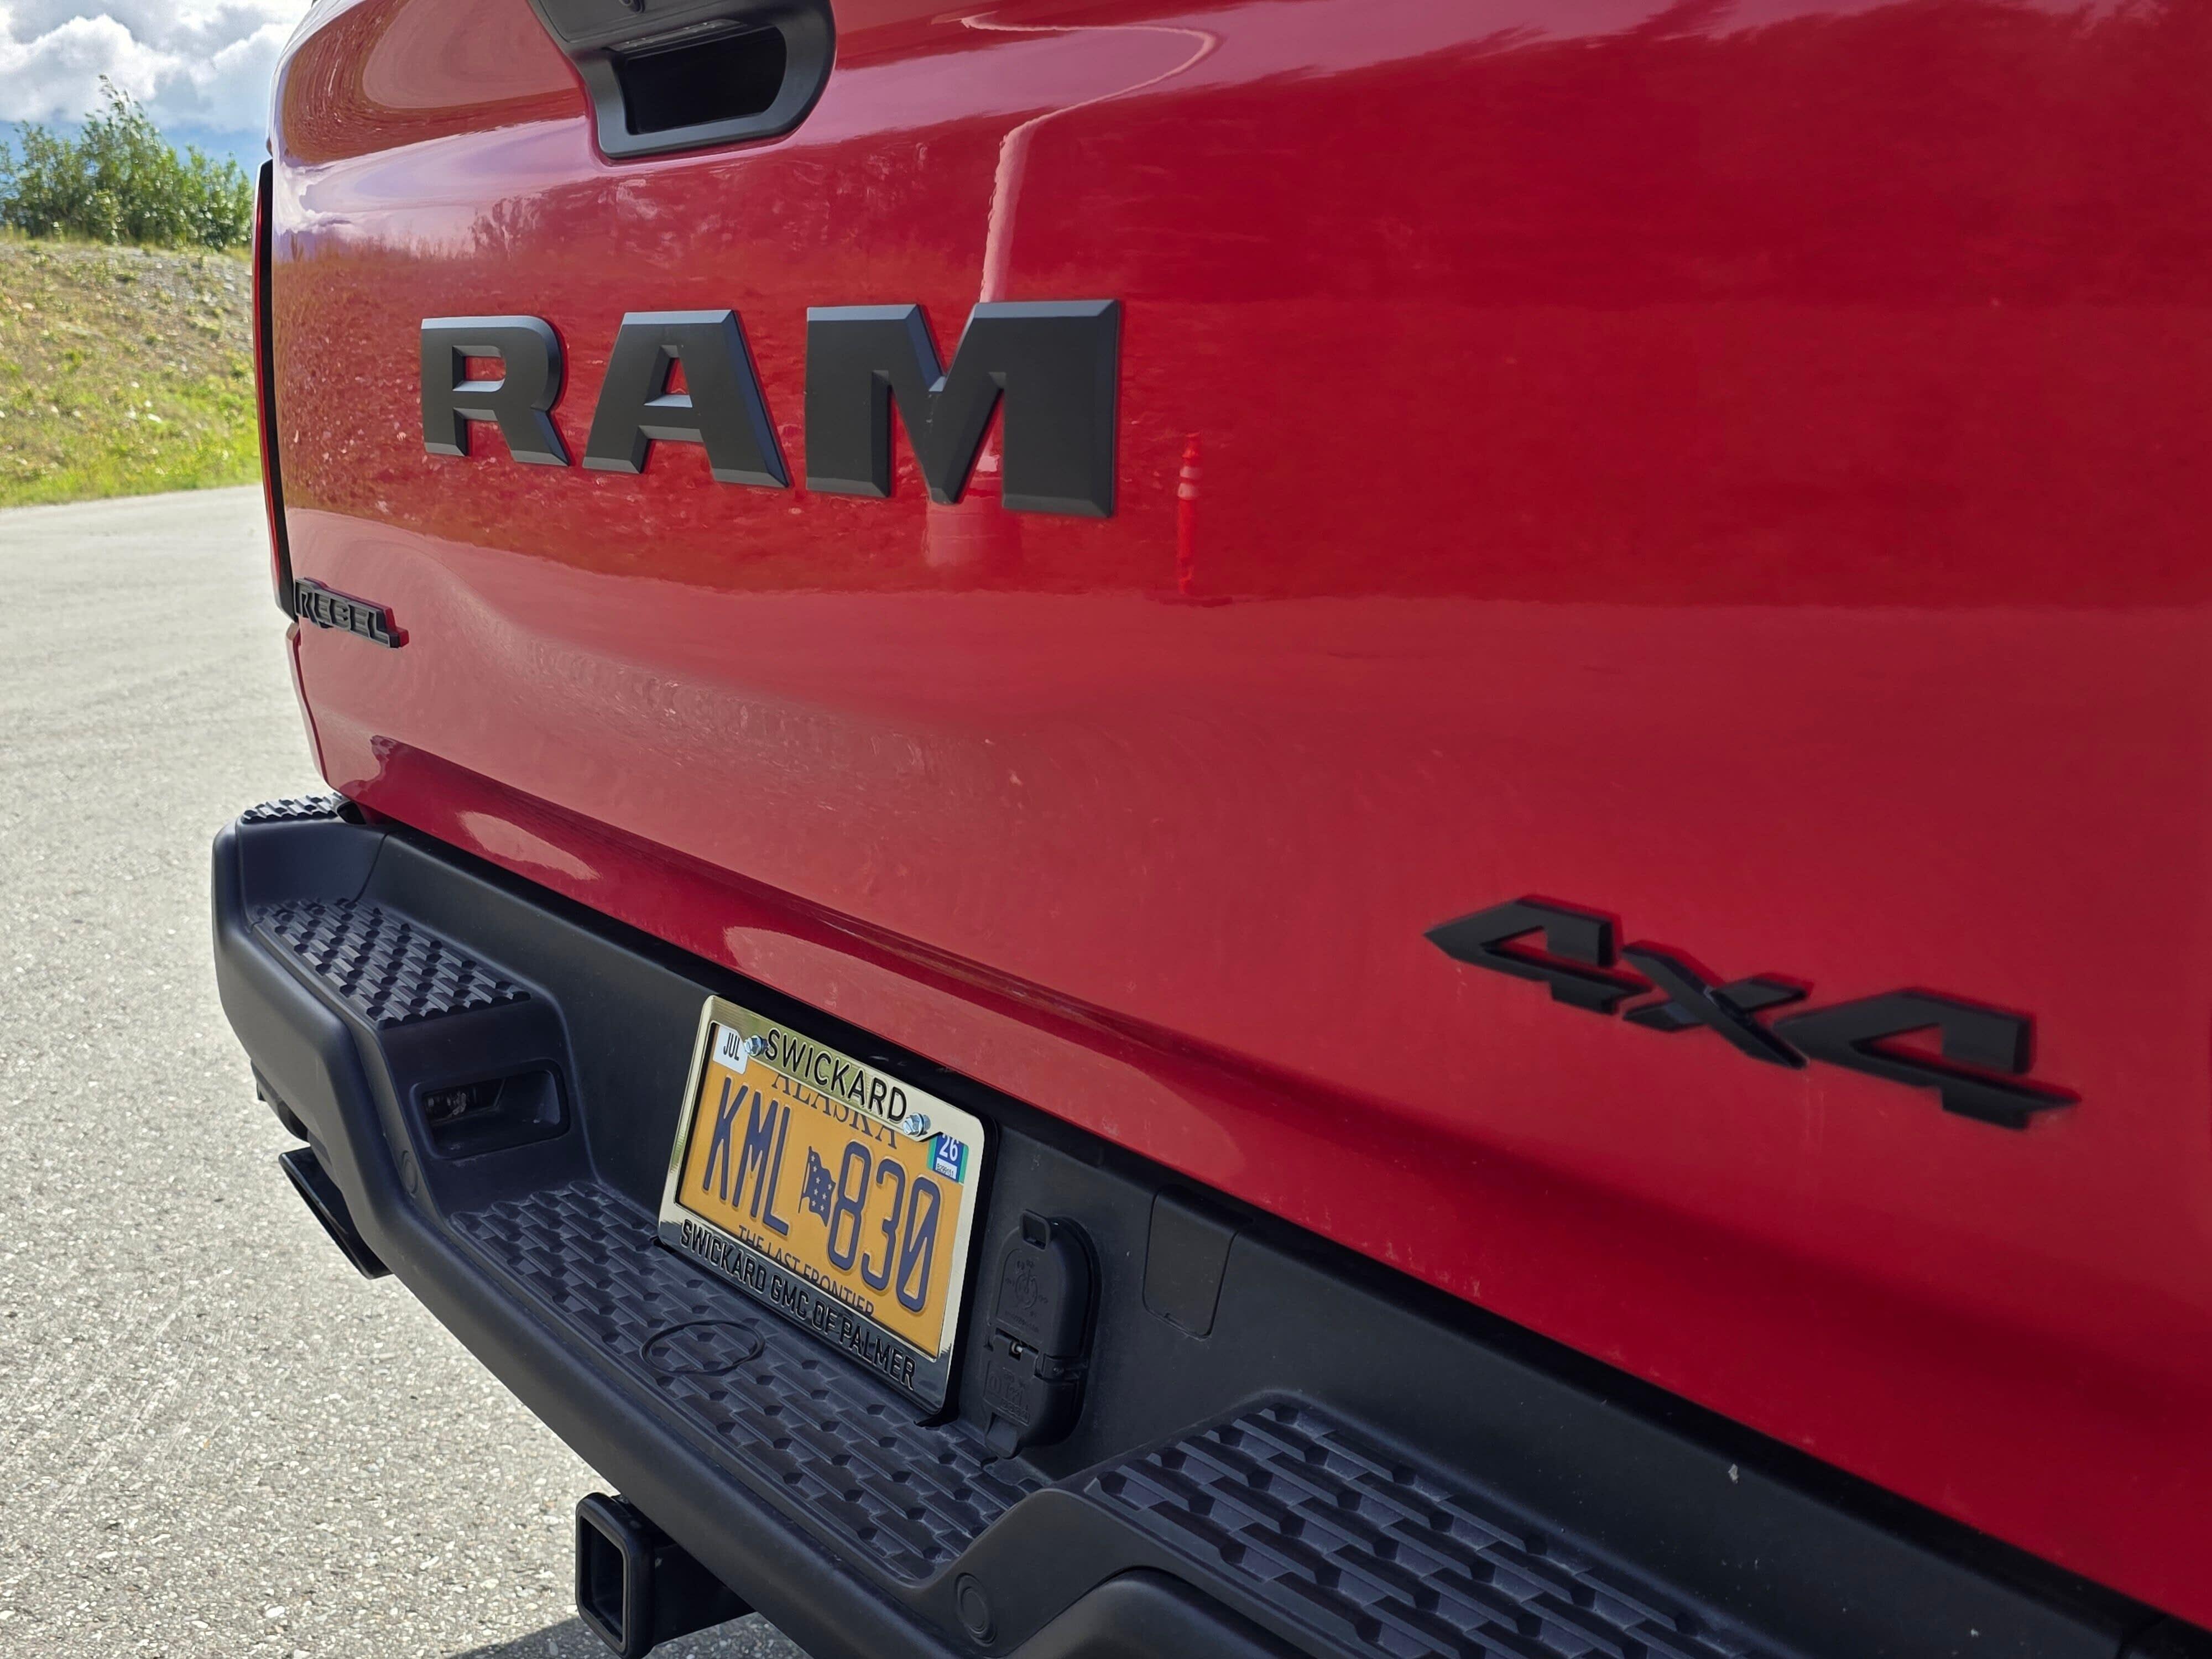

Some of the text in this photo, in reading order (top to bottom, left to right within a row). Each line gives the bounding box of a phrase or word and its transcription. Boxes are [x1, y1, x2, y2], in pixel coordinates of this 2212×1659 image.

[421, 299, 1120, 518] RAM
[295, 578, 403, 648] REBEL
[723, 1032, 740, 1061] JUL
[765, 1029, 907, 1122] SWICKARD
[939, 1133, 958, 1162] 26
[703, 1077, 941, 1313] KML 830
[739, 1224, 764, 1250] THE
[680, 1218, 917, 1391] SWICKARD GMC OF PALMER
